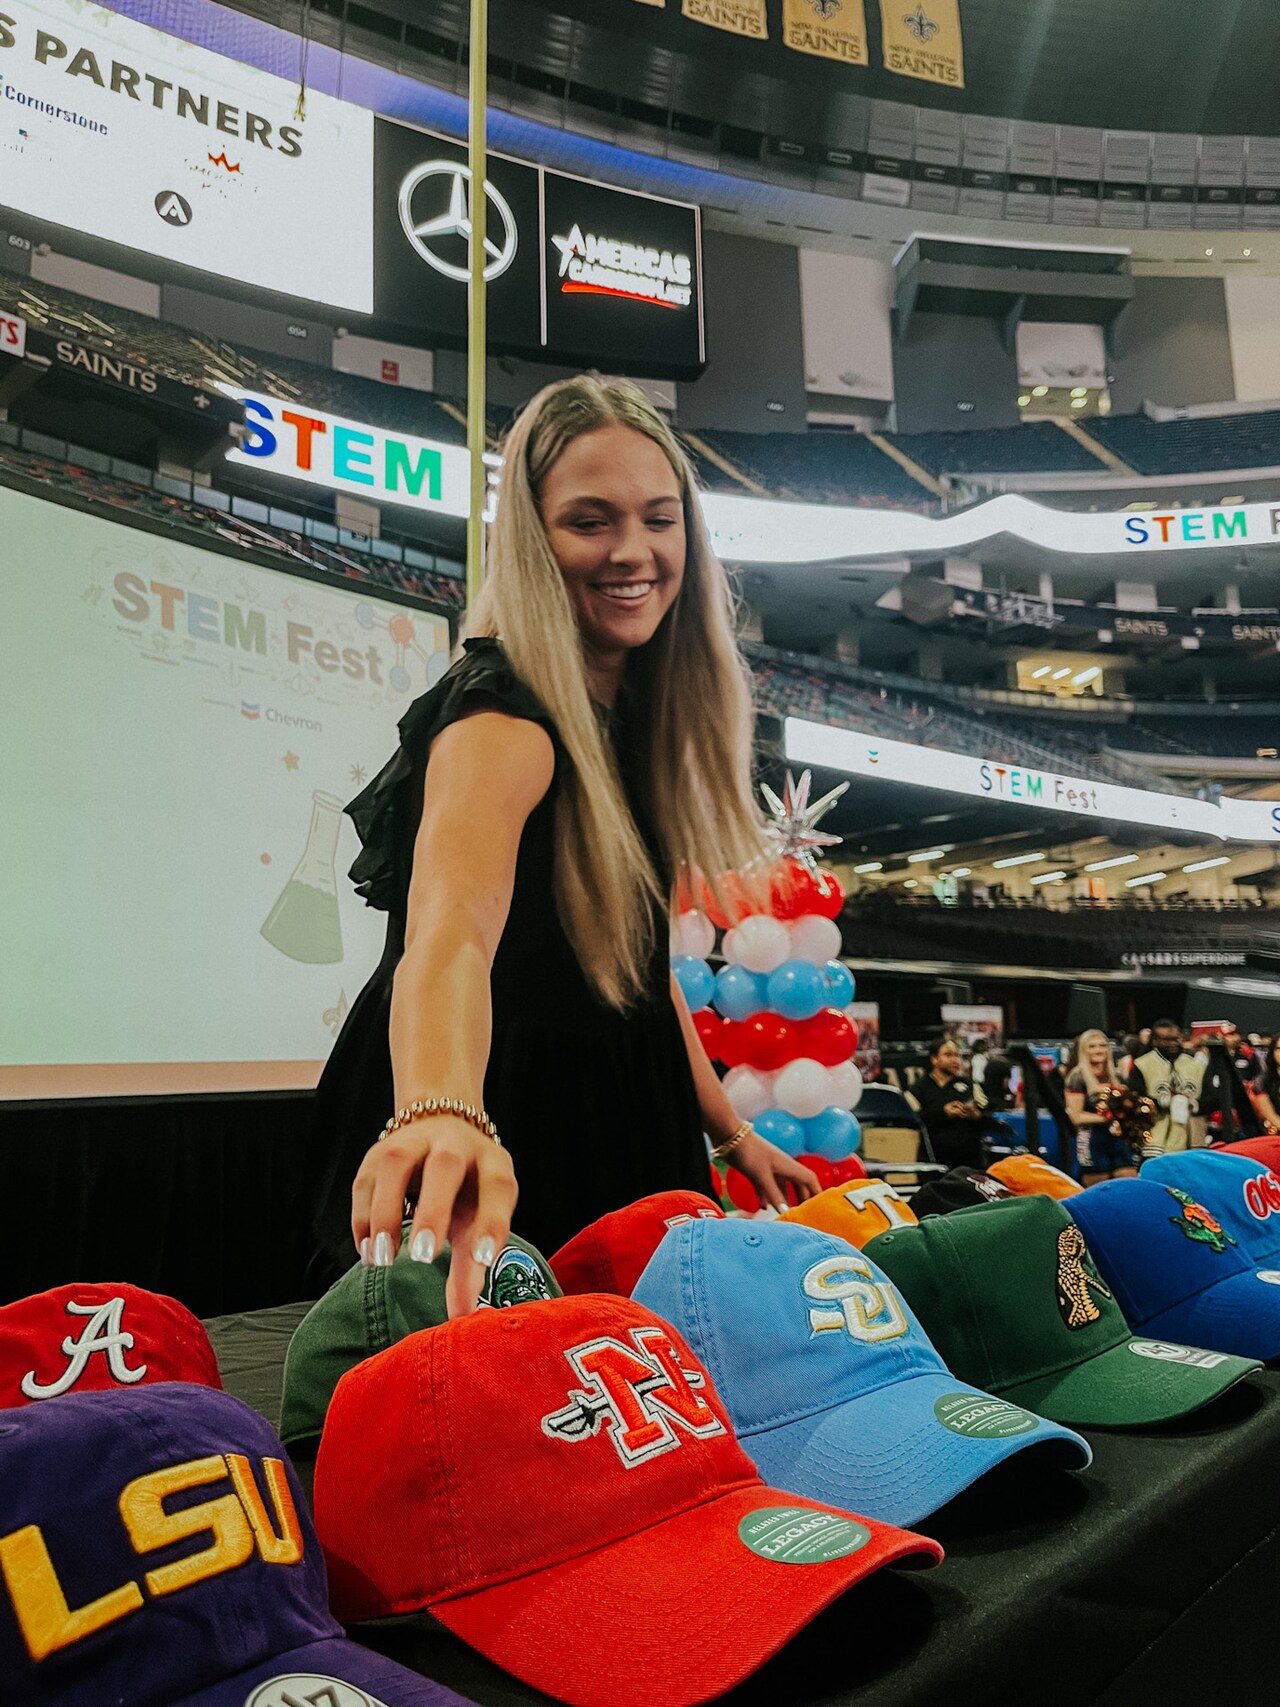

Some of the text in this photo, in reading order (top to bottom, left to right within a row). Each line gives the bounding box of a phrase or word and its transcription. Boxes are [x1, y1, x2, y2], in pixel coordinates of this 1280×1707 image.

[788, 30, 861, 59] SAINTS
[889, 53, 959, 82] SAINTS
[5, 85, 108, 136] Cornerstone
[34, 29, 304, 158] PARTNERS
[56, 341, 157, 393] SAINTS
[243, 398, 442, 501] STEM
[1125, 511, 1248, 544] STEM
[112, 571, 384, 686] STEM Fest
[264, 707, 323, 733] Chevron
[980, 764, 1098, 810] STEM Fest
[20, 1297, 147, 1400] A
[950, 1404, 1014, 1429] LEGACY
[0, 1453, 304, 1663] LSU
[761, 1514, 840, 1555] LEGACY
